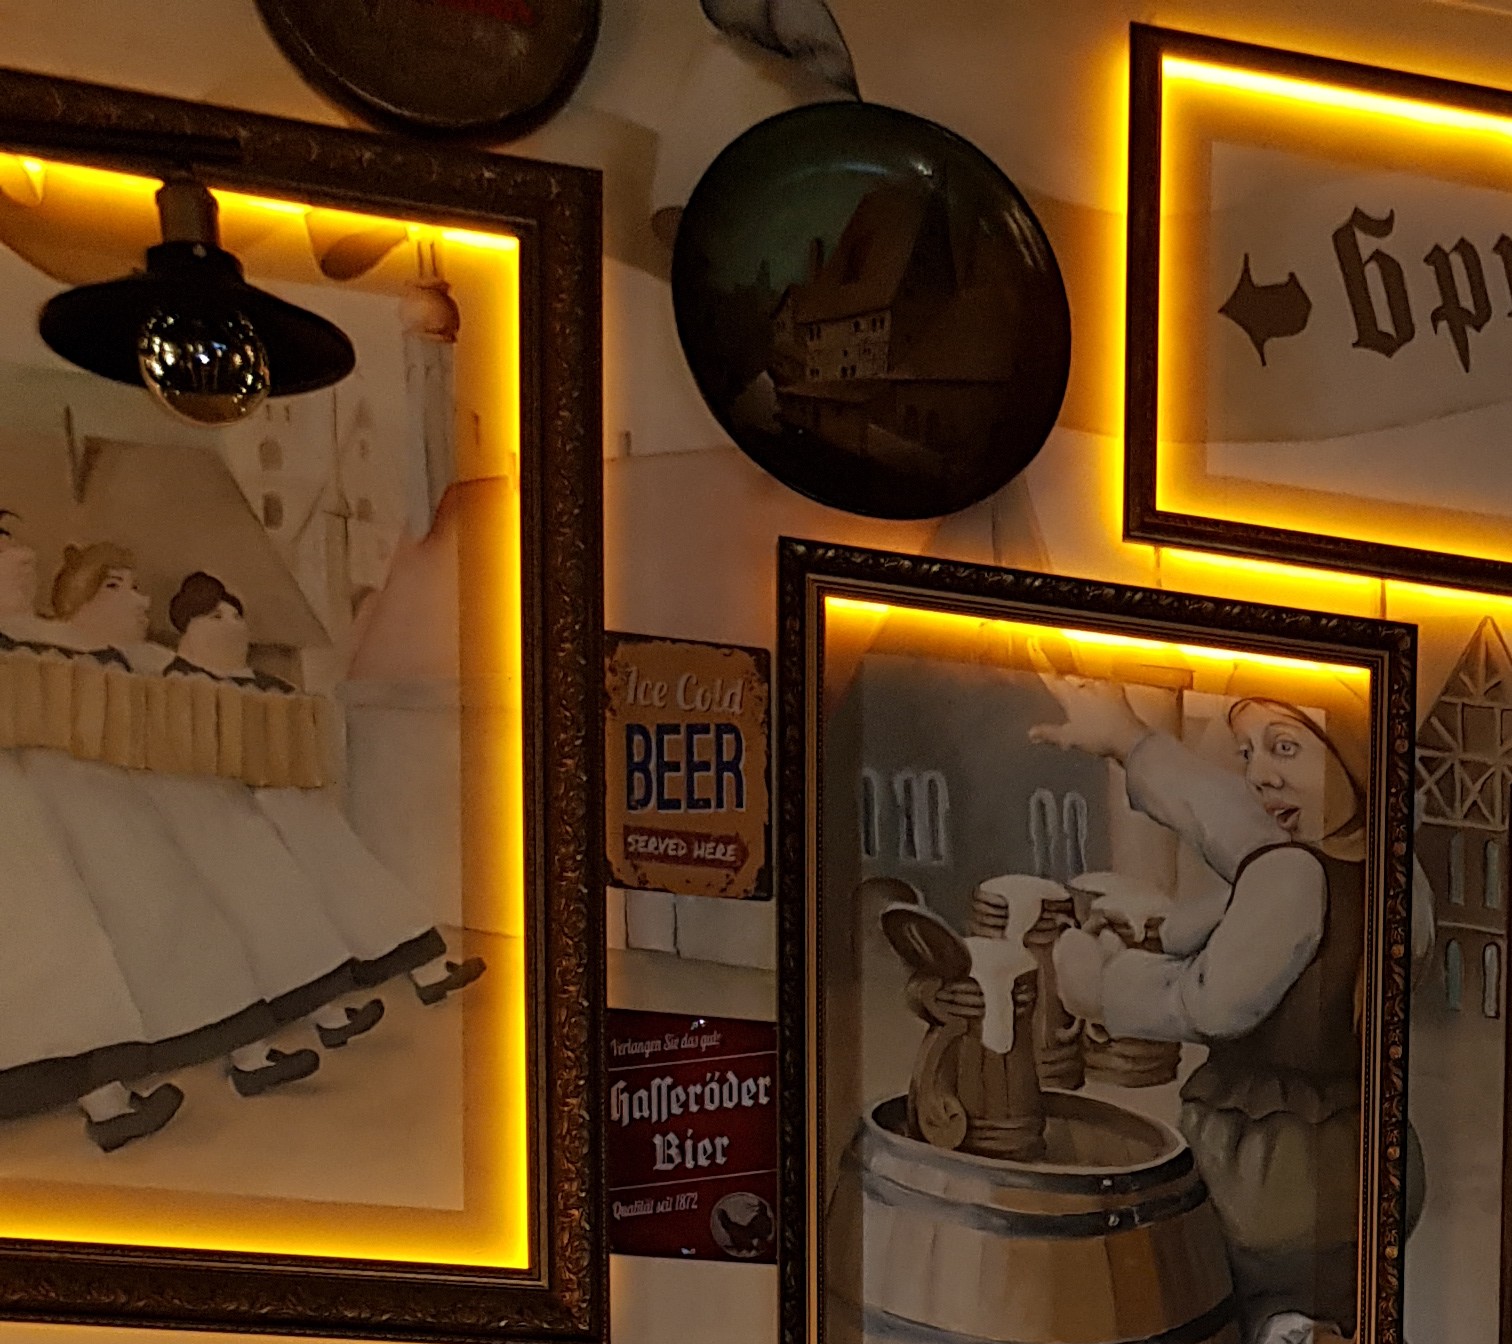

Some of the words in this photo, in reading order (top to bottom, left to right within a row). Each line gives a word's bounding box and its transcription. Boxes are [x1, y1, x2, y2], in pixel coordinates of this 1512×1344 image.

[624, 666, 669, 709] Ice
[676, 673, 746, 716] Cold
[625, 722, 747, 815] BEER
[626, 833, 687, 858] SERVED
[692, 841, 738, 862] HERE
[652, 1128, 730, 1171] Bier
[675, 1192, 699, 1211] 1872
